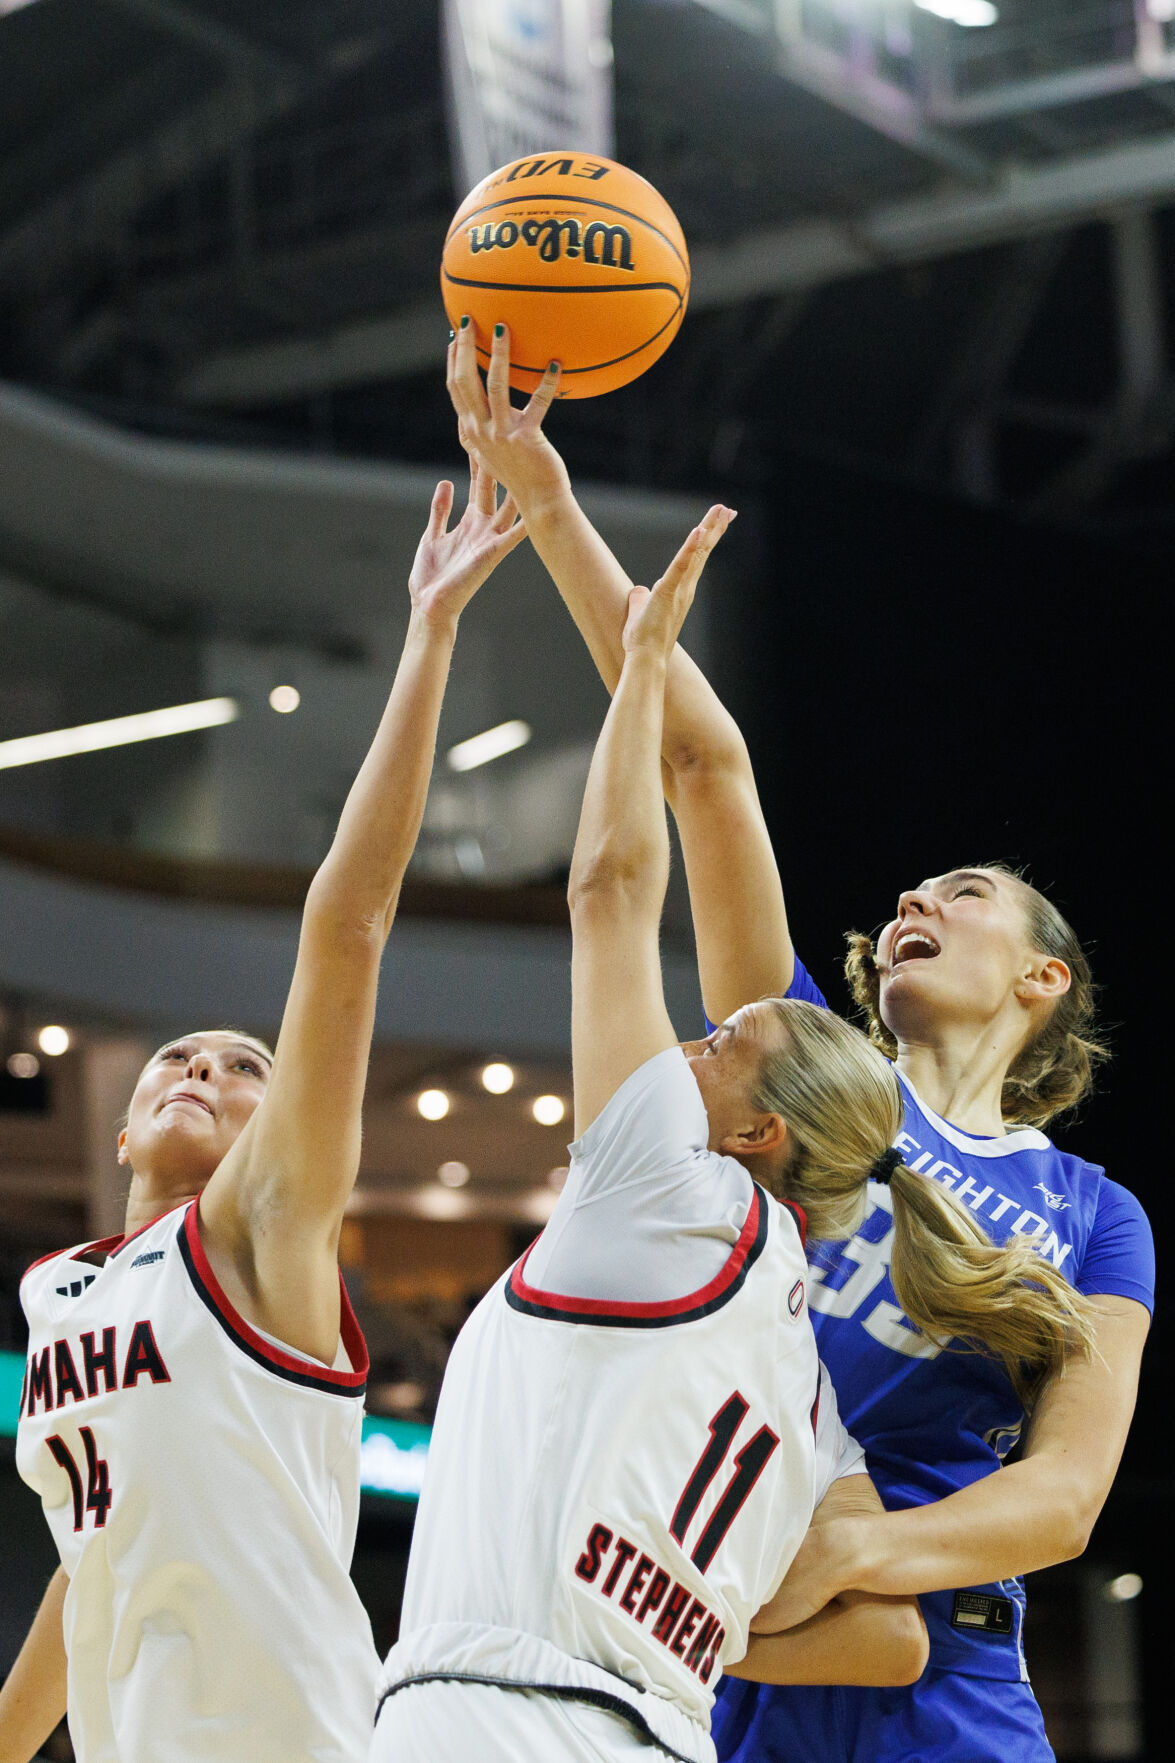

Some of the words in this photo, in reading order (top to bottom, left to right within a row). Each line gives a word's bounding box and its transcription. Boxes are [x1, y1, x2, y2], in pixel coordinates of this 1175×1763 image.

[468, 218, 636, 272] Wilson
[892, 1131, 1073, 1270] EIGHTON
[18, 1320, 171, 1422] MAHA
[45, 1426, 112, 1532] 14
[669, 1389, 780, 1576] 11
[575, 1522, 725, 1685] STEPHENS
[995, 1608, 1003, 1622] L
